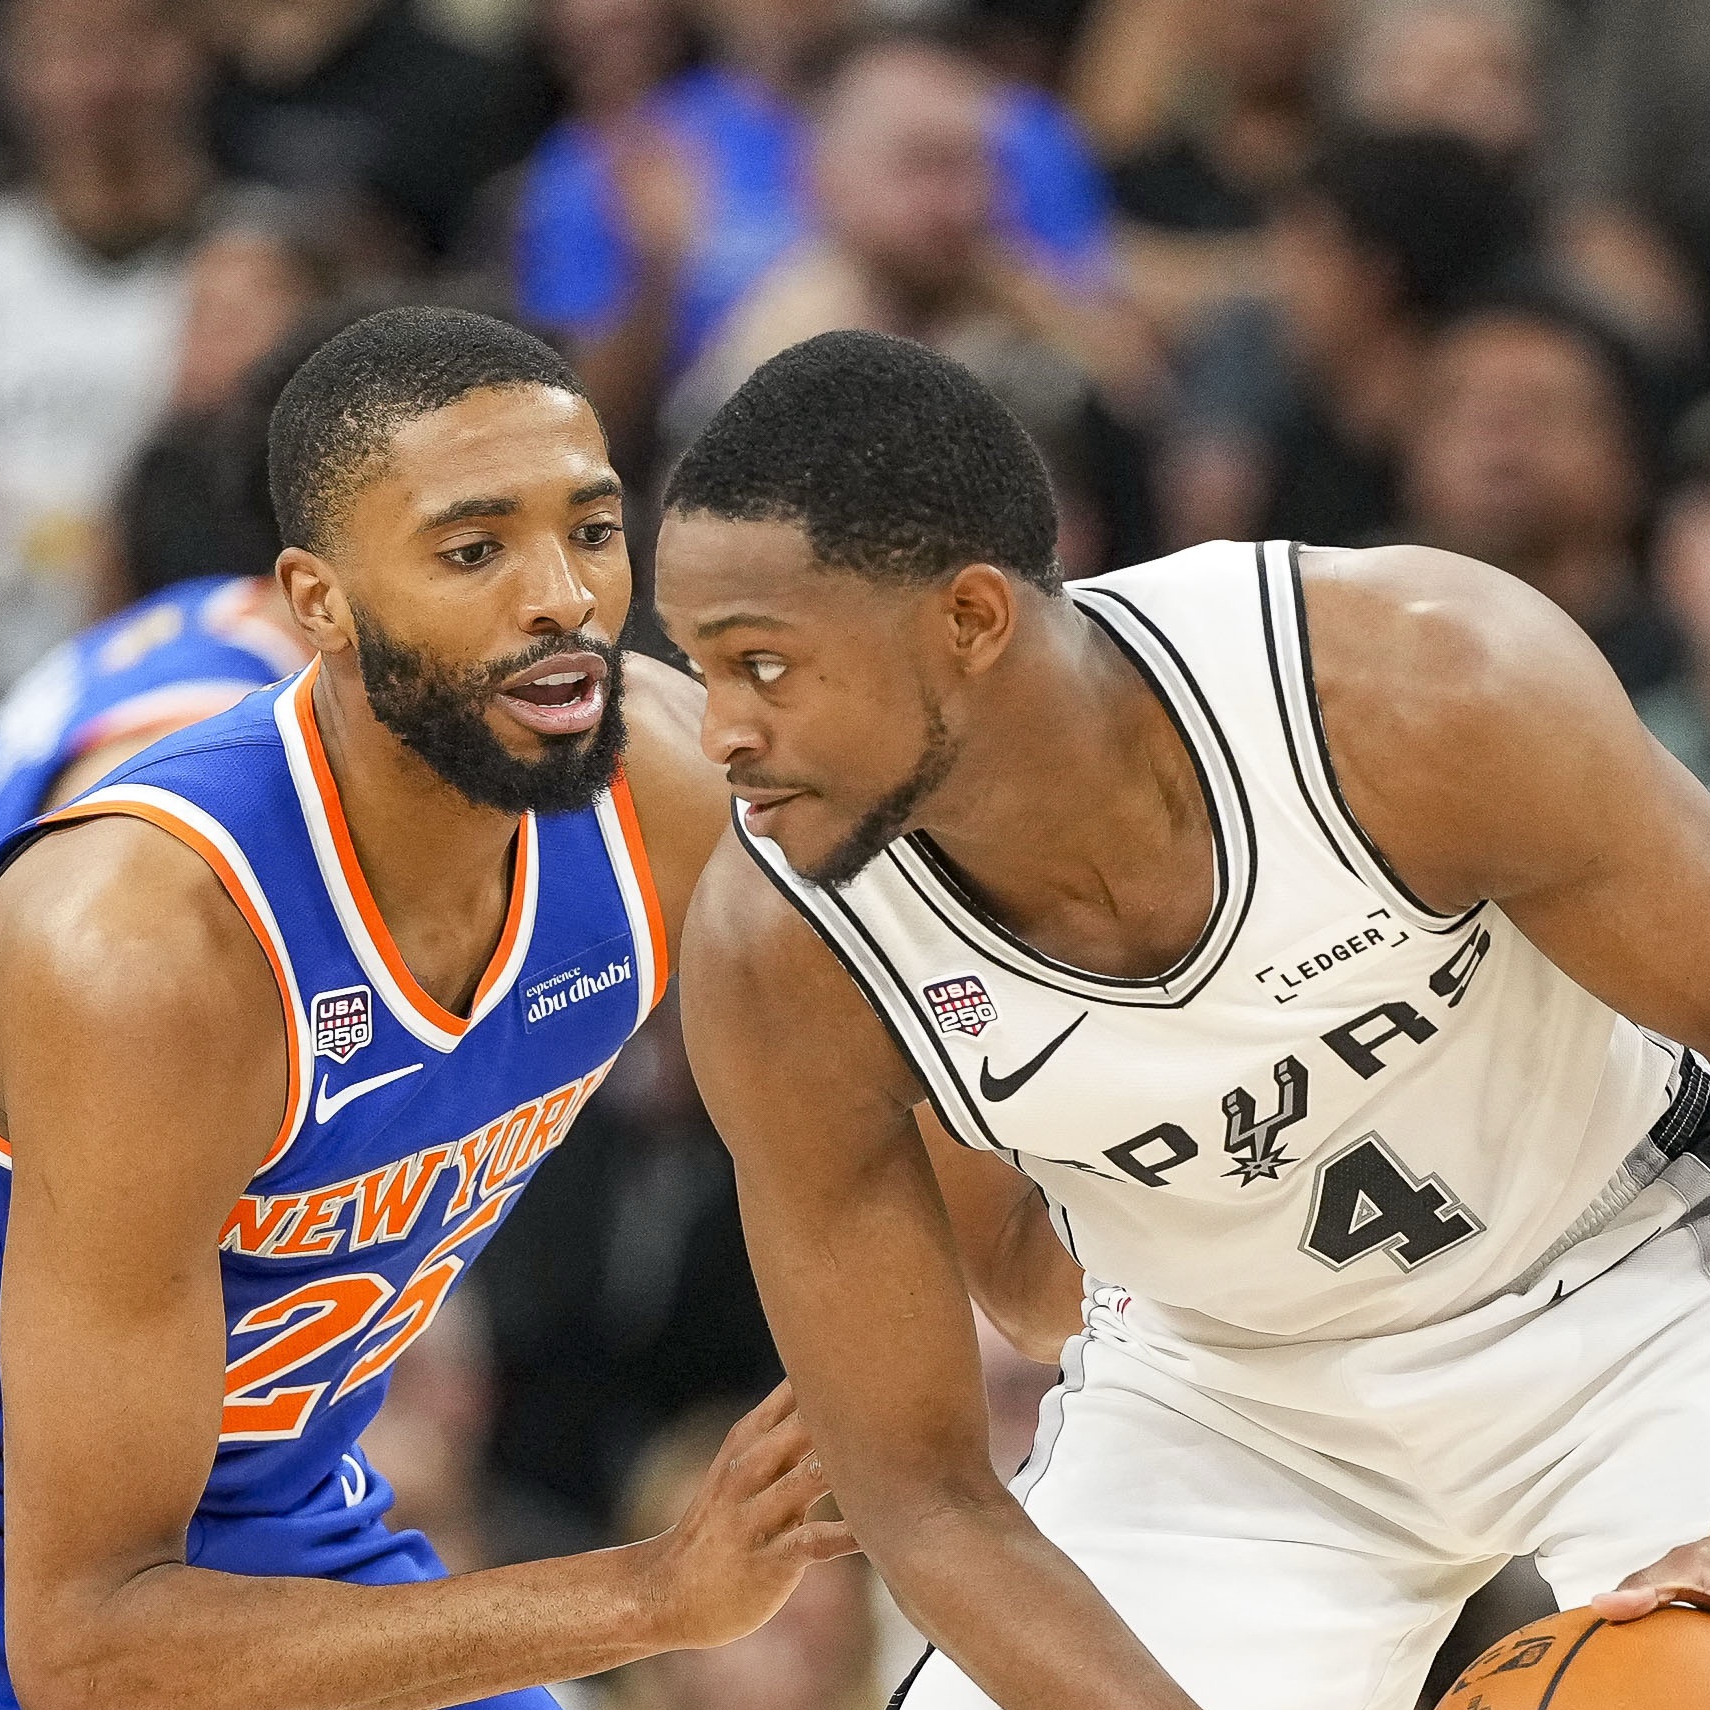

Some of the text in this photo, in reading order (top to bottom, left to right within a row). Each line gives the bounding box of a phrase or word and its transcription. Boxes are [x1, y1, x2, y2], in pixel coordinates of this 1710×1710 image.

[525, 966, 582, 998] experience
[1280, 927, 1386, 988] LEDGER
[320, 997, 366, 1019] USA
[527, 955, 632, 1023] abu dhabi
[929, 980, 984, 1004] USA
[937, 1003, 998, 1033] 250
[317, 1023, 369, 1051] 250
[1034, 922, 1490, 1188] PURS
[219, 1141, 458, 1259] NEW
[1297, 1130, 1487, 1273] 4
[218, 1182, 525, 1443] 25
